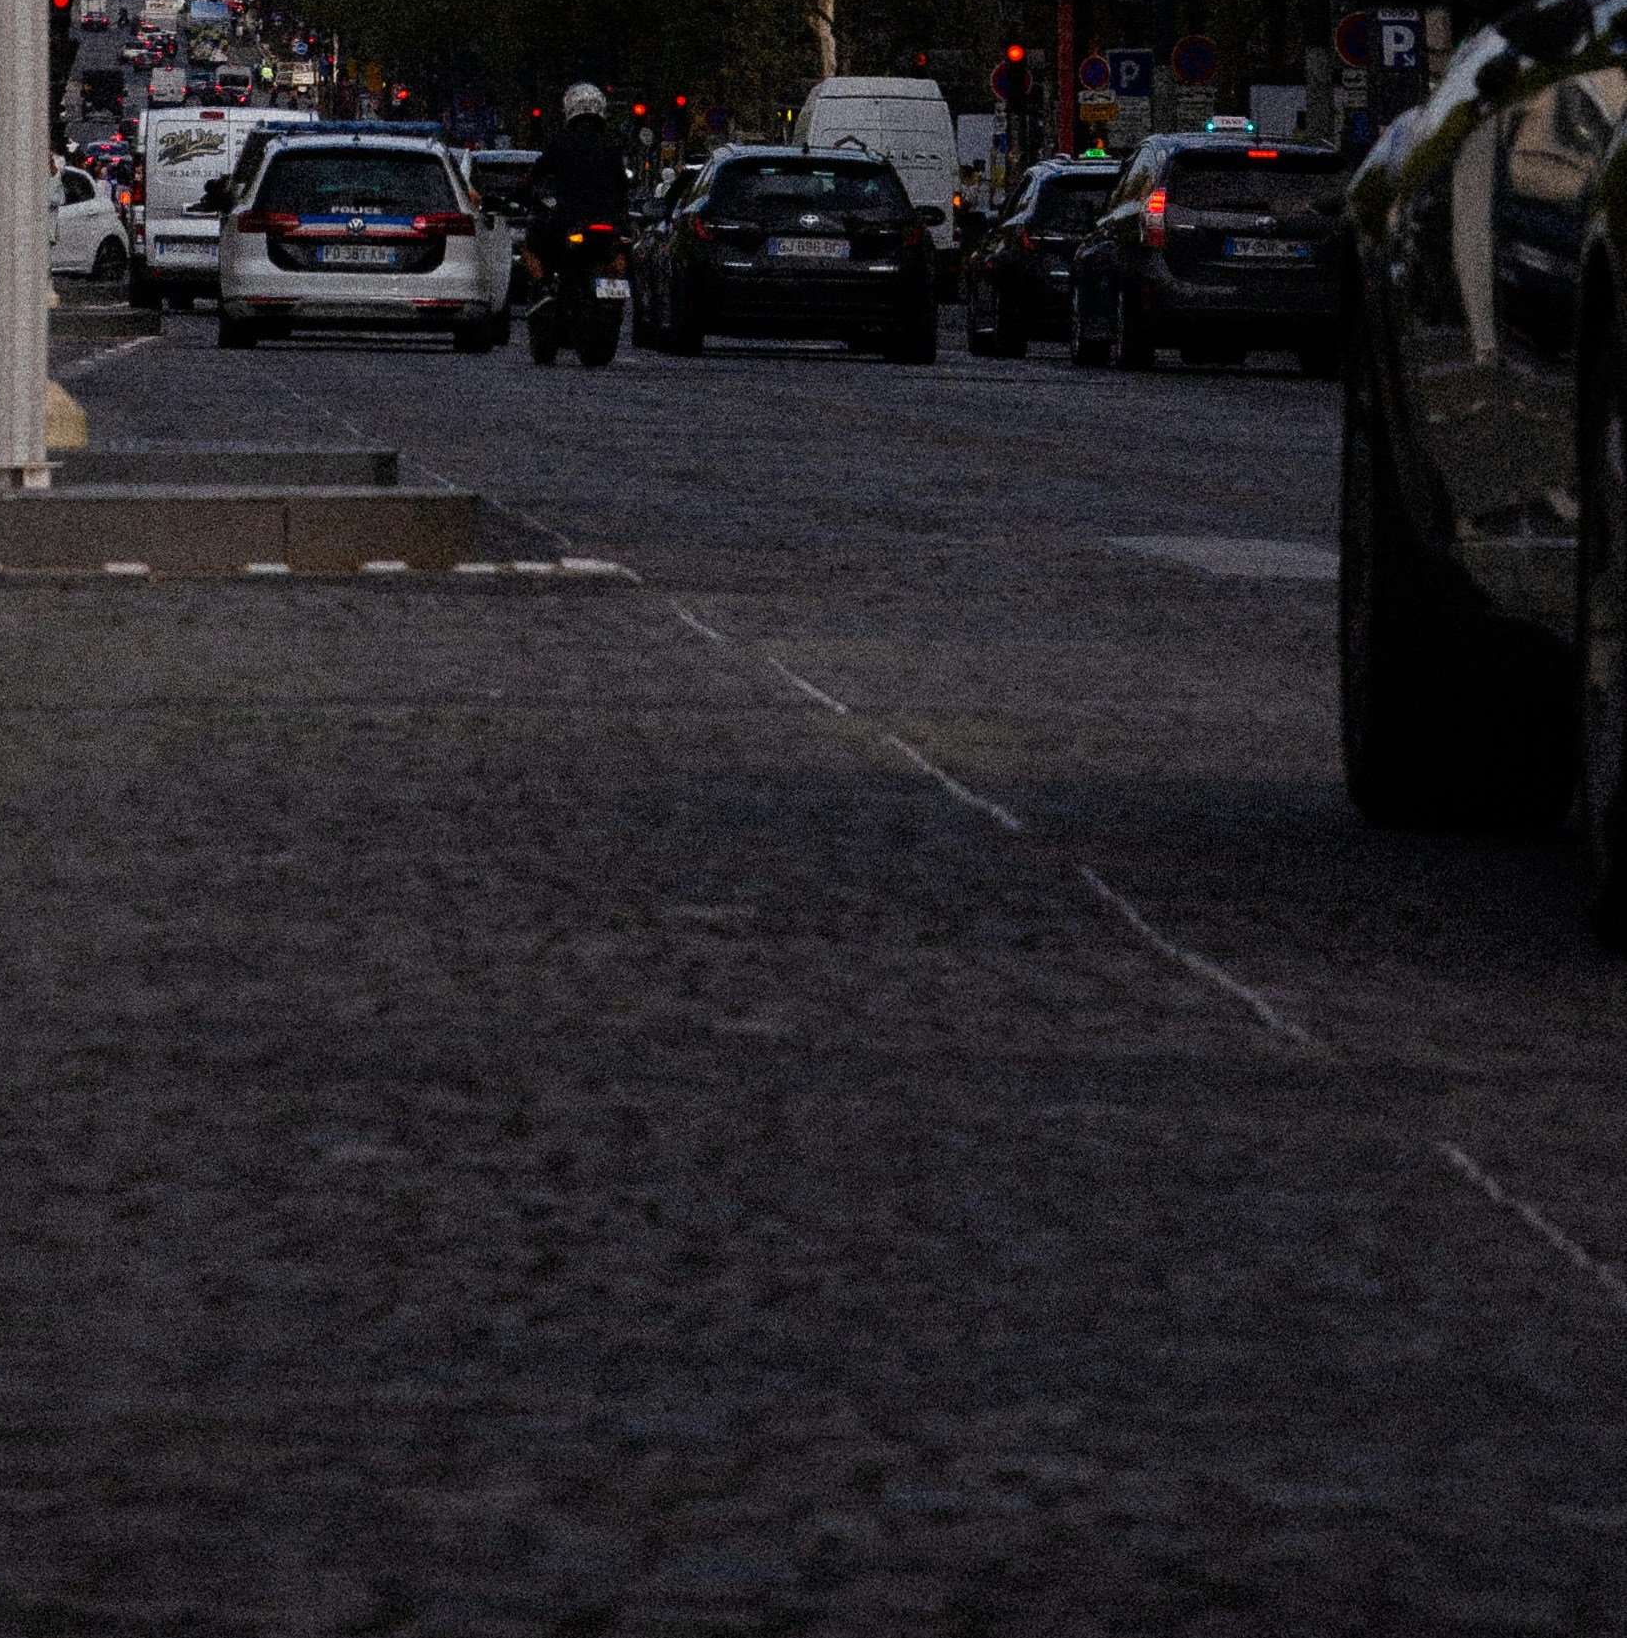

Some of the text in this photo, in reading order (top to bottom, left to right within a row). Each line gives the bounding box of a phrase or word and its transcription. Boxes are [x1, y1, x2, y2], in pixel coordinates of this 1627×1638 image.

[1382, 24, 1415, 66] P
[1119, 58, 1140, 88] P
[330, 205, 382, 214] POLICE
